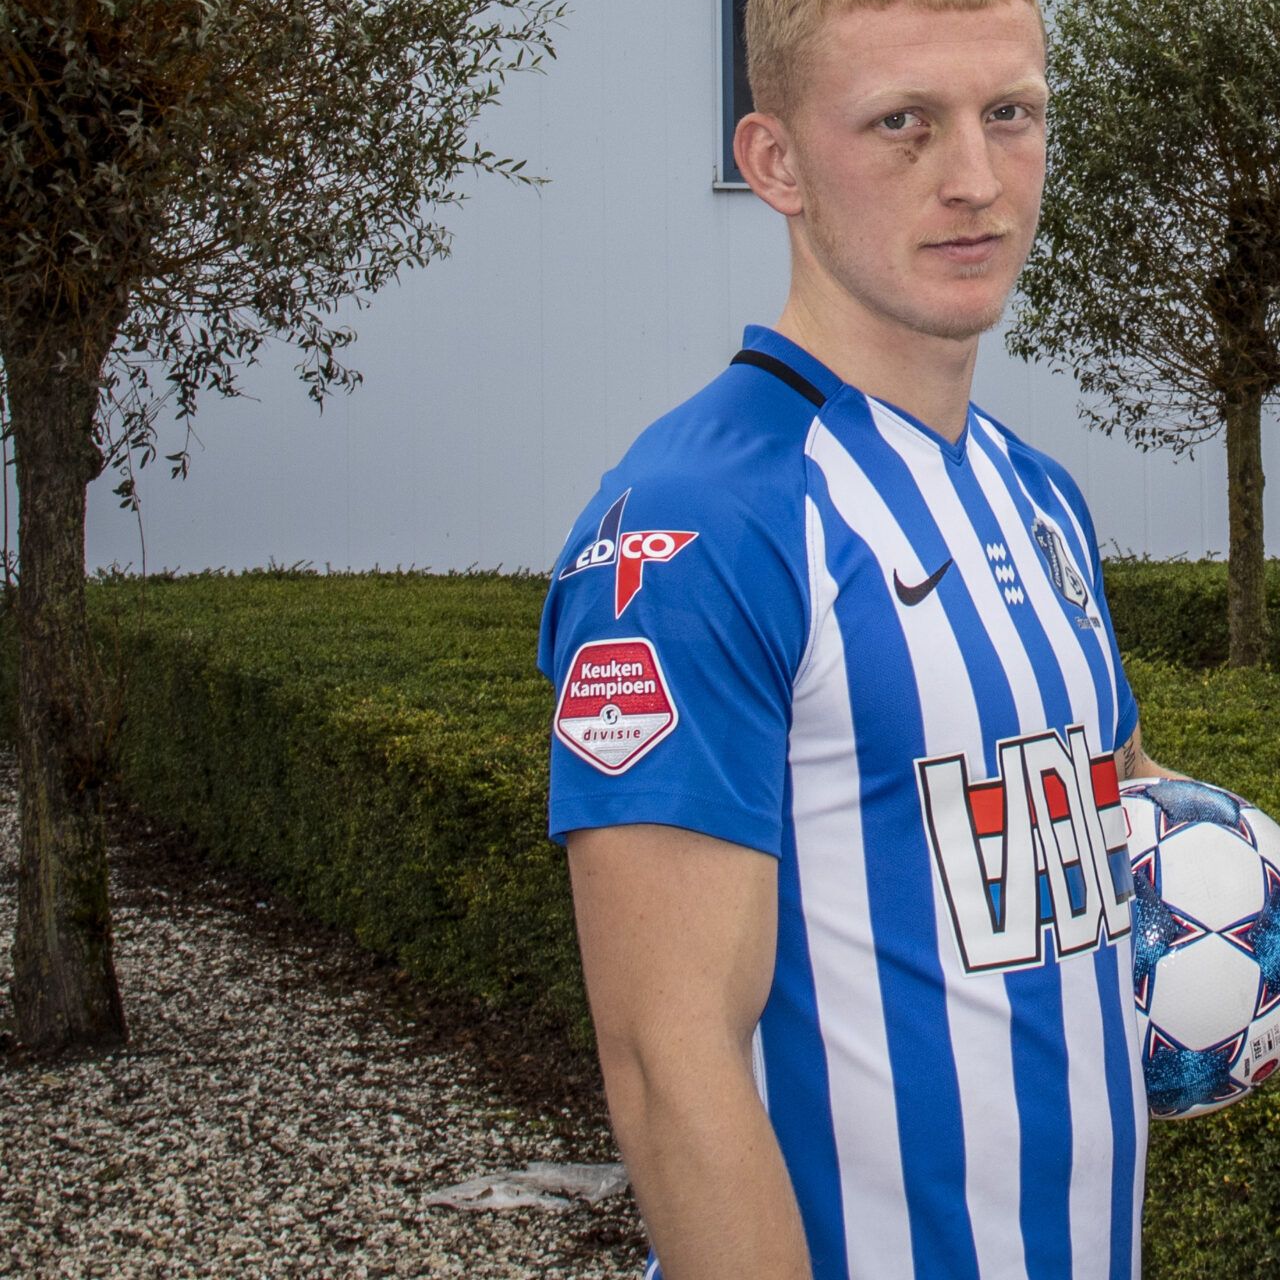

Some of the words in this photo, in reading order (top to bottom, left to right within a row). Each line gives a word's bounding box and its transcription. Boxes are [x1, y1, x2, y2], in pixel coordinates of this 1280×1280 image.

[575, 532, 676, 570] EDCO
[581, 659, 643, 679] Keuken
[570, 677, 656, 700] Kampioen
[914, 723, 1134, 977] VDL
